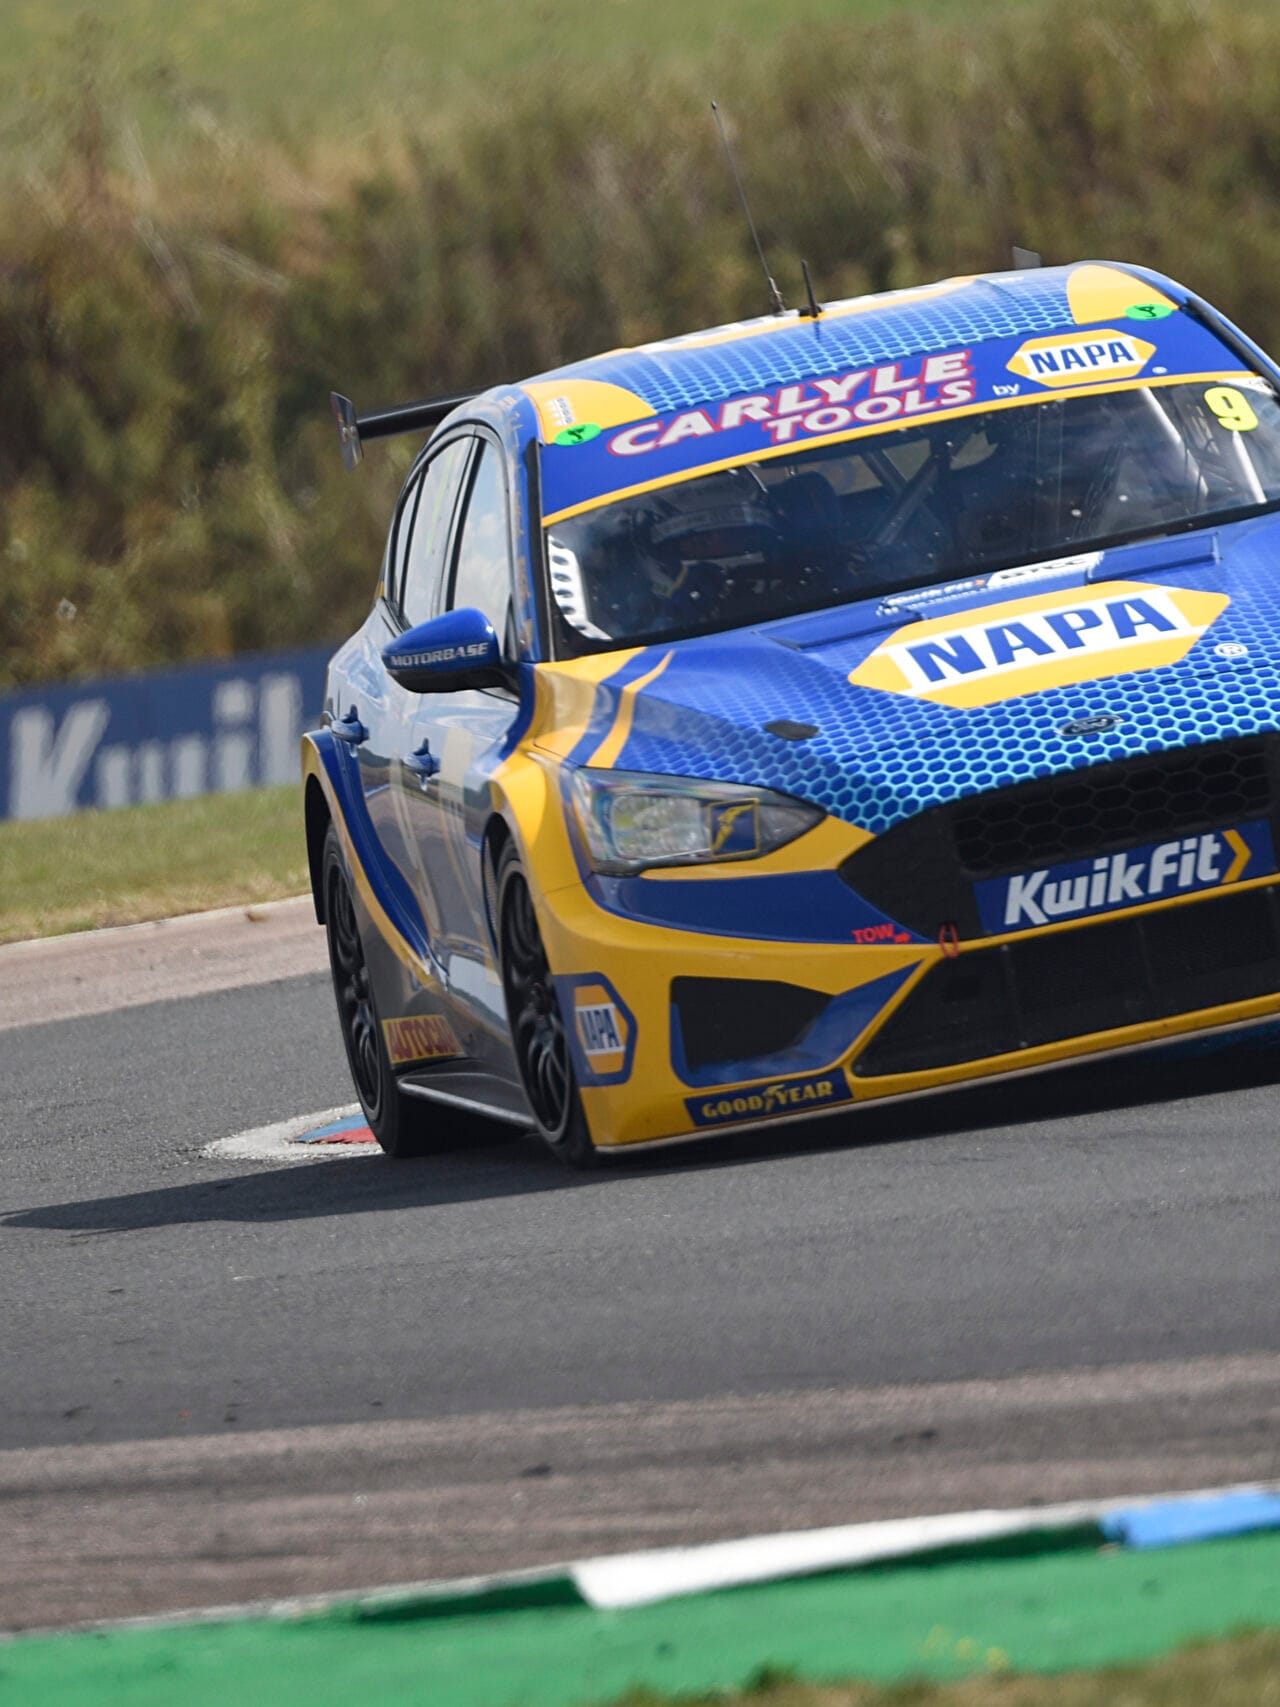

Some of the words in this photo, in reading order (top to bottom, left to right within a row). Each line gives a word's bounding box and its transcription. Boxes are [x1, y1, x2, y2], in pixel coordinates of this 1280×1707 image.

[1029, 340, 1135, 374] NAPA
[608, 350, 971, 457] CARLYLE
[768, 380, 975, 443] TOOLS
[992, 382, 1020, 397] by
[1204, 386, 1259, 431] 9
[390, 642, 489, 666] MOTORBASE
[905, 597, 1179, 683] NAPA
[1004, 853, 1146, 925] Kwik
[1148, 833, 1222, 894] Fit
[852, 923, 894, 944] TOW
